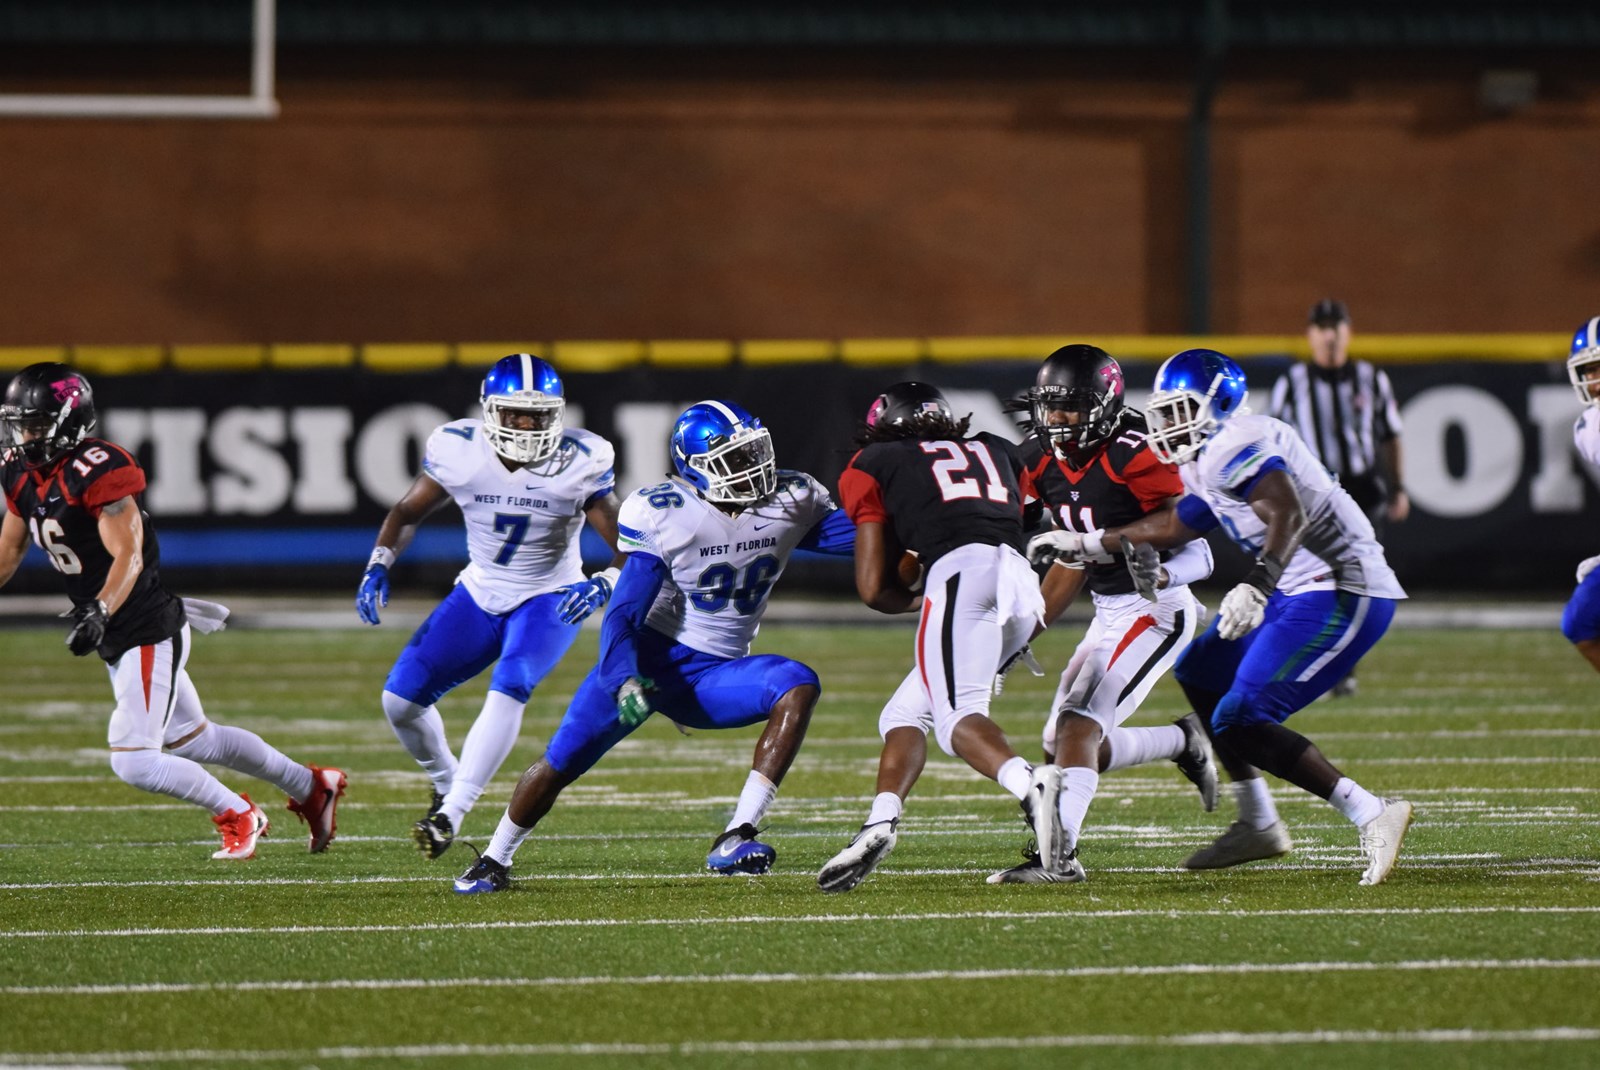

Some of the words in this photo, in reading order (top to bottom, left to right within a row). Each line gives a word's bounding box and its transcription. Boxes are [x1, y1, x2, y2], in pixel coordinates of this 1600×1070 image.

[1045, 385, 1060, 393] VSU
[443, 427, 475, 441] 7
[1116, 429, 1149, 448] 11
[72, 446, 110, 477] 16
[919, 440, 1009, 503] 21
[474, 494, 501, 504] WEST
[507, 496, 549, 509] FLORIDA
[638, 482, 685, 510] 36
[29, 516, 83, 575] 16
[493, 512, 532, 567] 7
[699, 544, 730, 558] WEST
[736, 537, 777, 552] FLORIDA
[688, 553, 781, 616] 36
